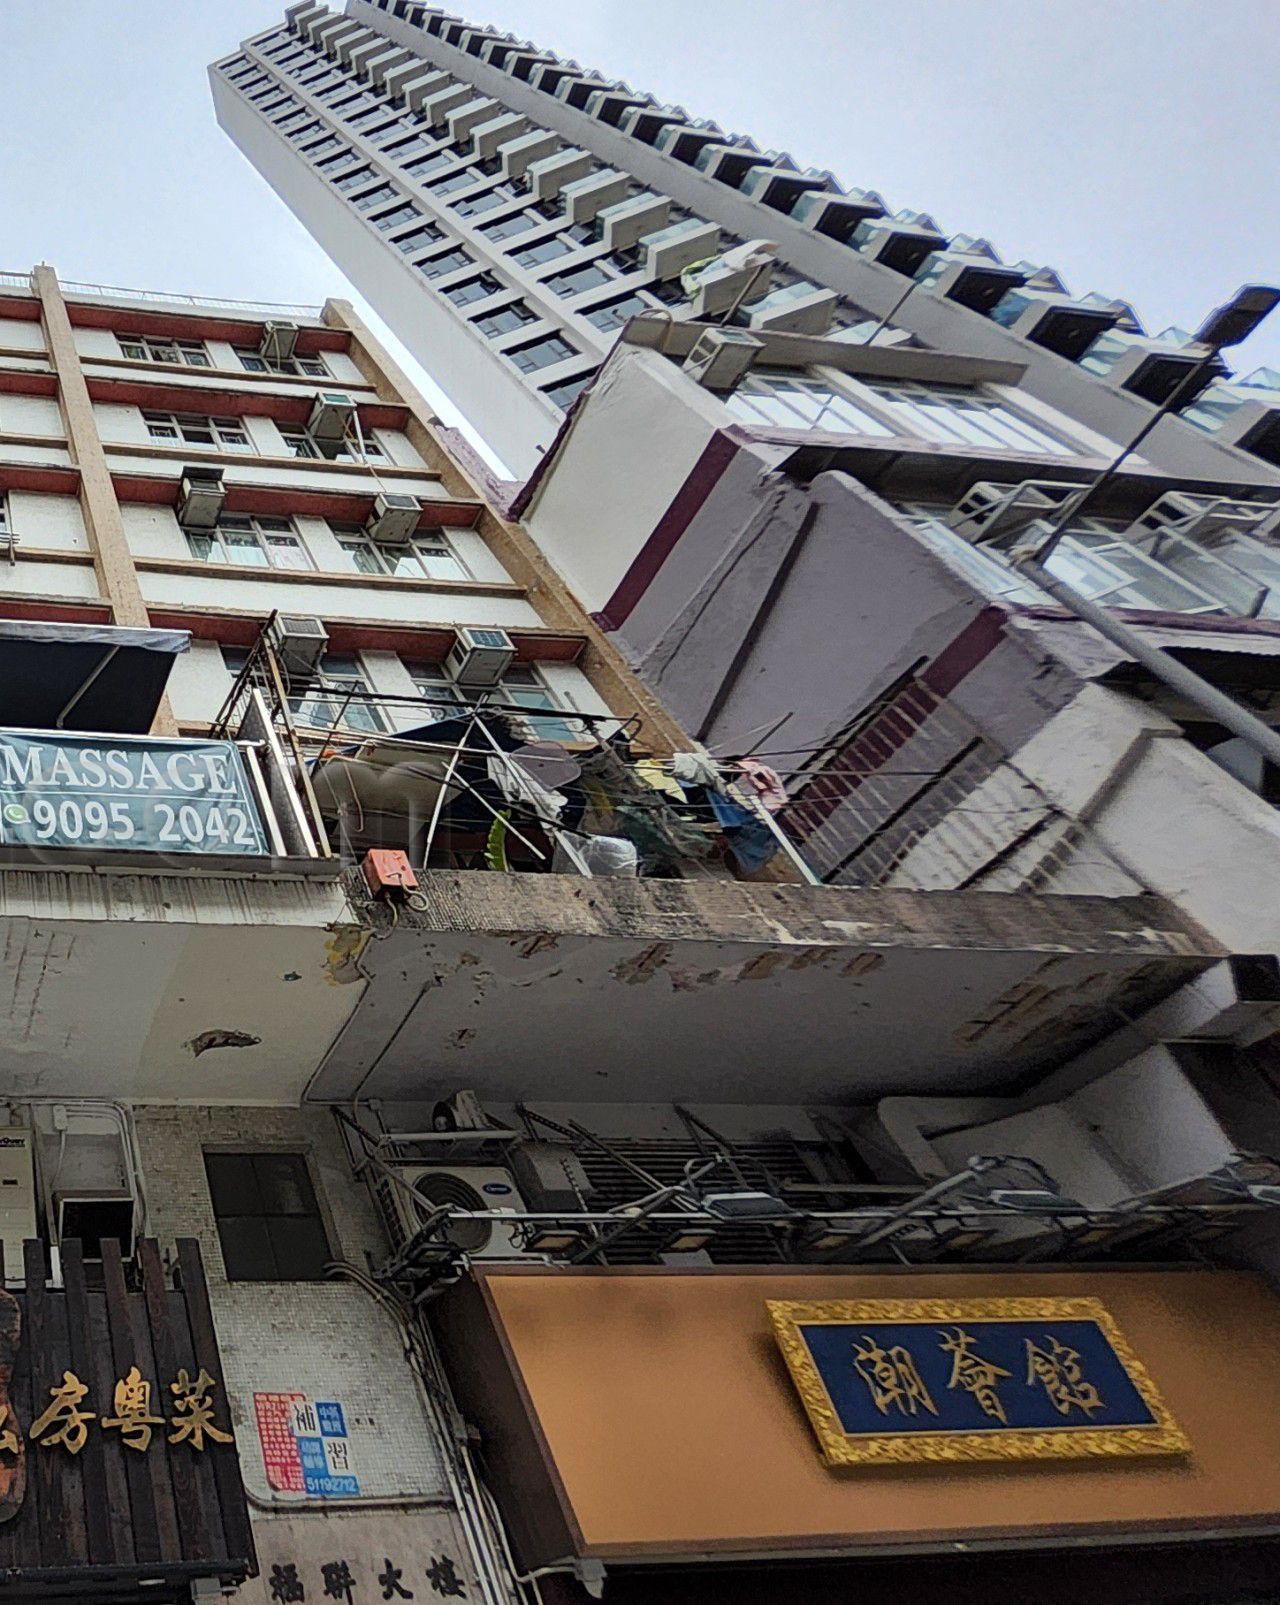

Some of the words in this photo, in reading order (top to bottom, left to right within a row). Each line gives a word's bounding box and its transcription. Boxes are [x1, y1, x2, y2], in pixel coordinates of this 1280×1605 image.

[0, 745, 237, 794] MASSAGE
[32, 799, 136, 841] 9095
[154, 804, 255, 846] 2042
